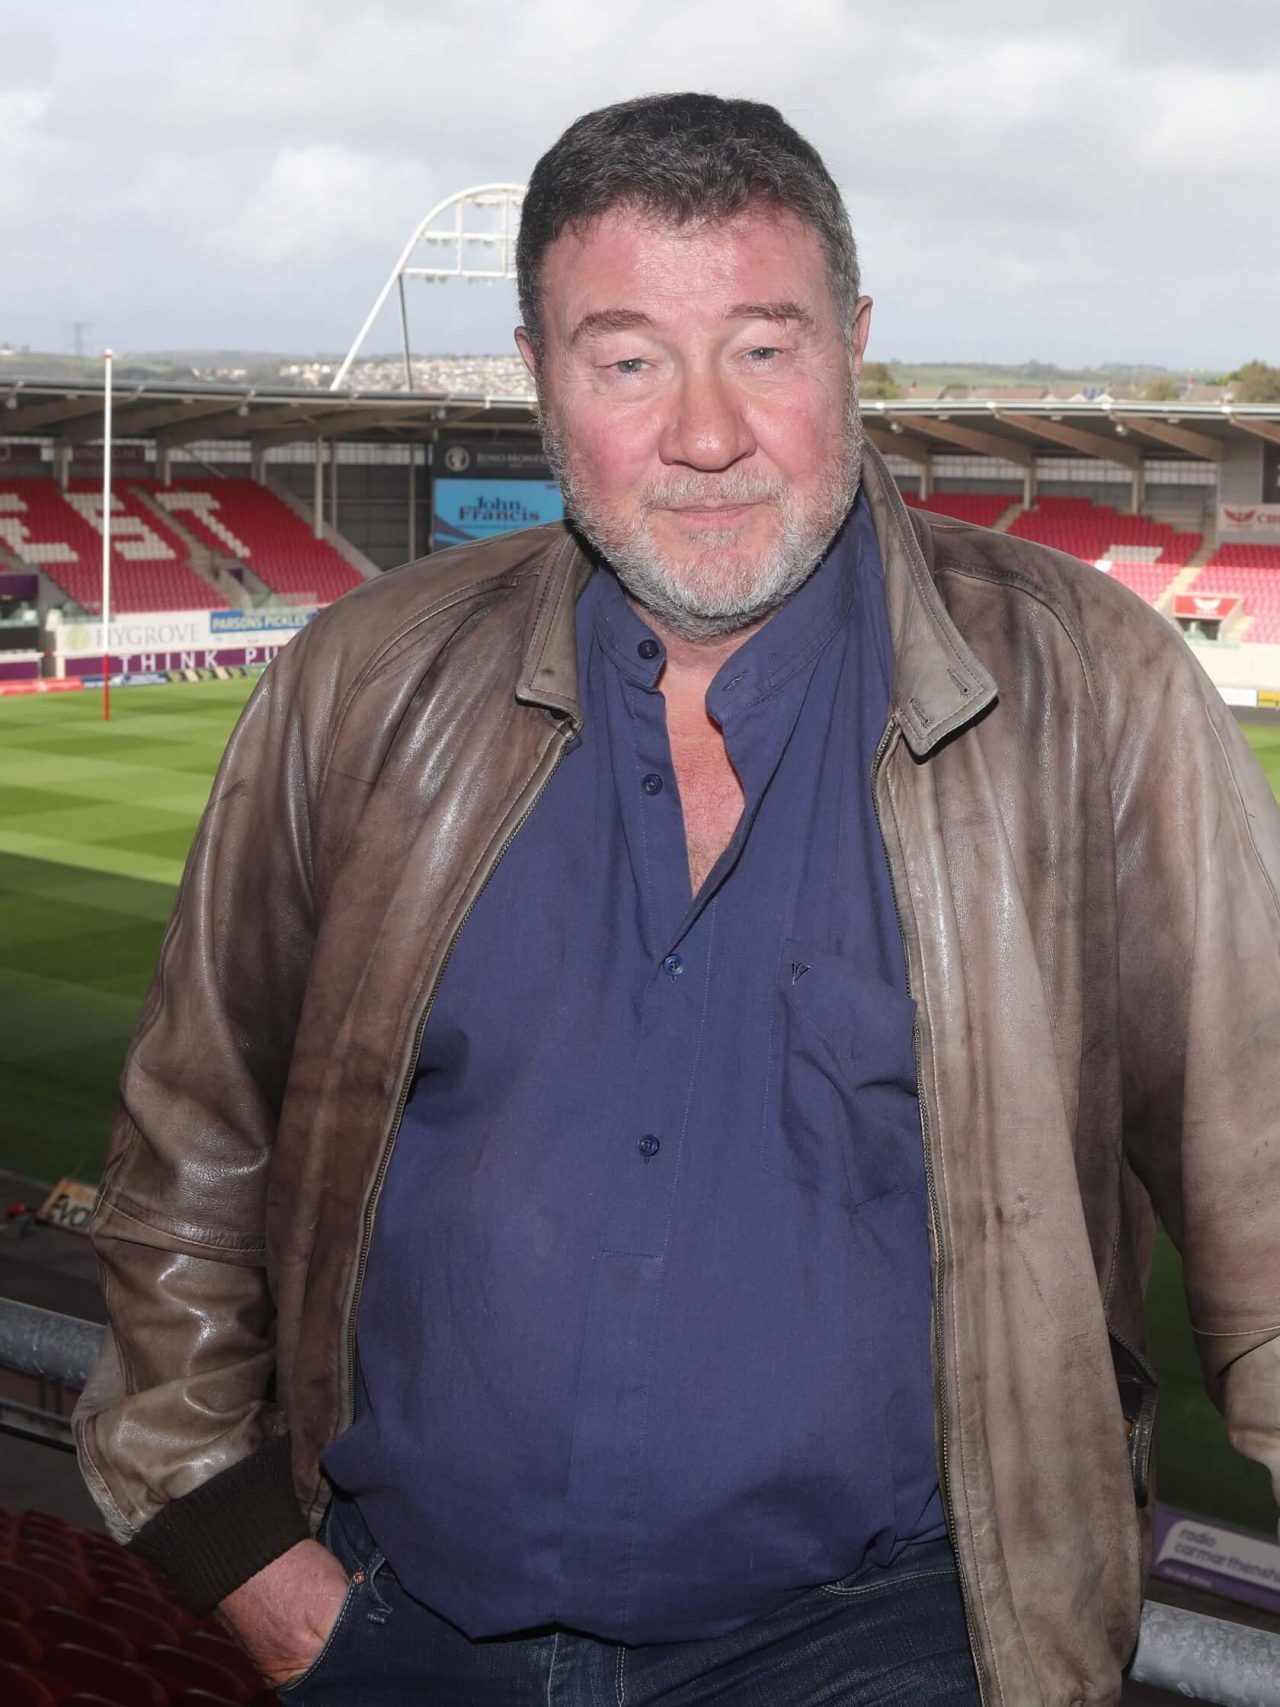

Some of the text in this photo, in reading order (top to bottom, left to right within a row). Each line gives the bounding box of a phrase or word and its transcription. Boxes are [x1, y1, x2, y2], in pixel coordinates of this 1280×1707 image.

[458, 505, 540, 521] Francis
[118, 650, 219, 674] THINK
[1180, 1528, 1216, 1547] radio
